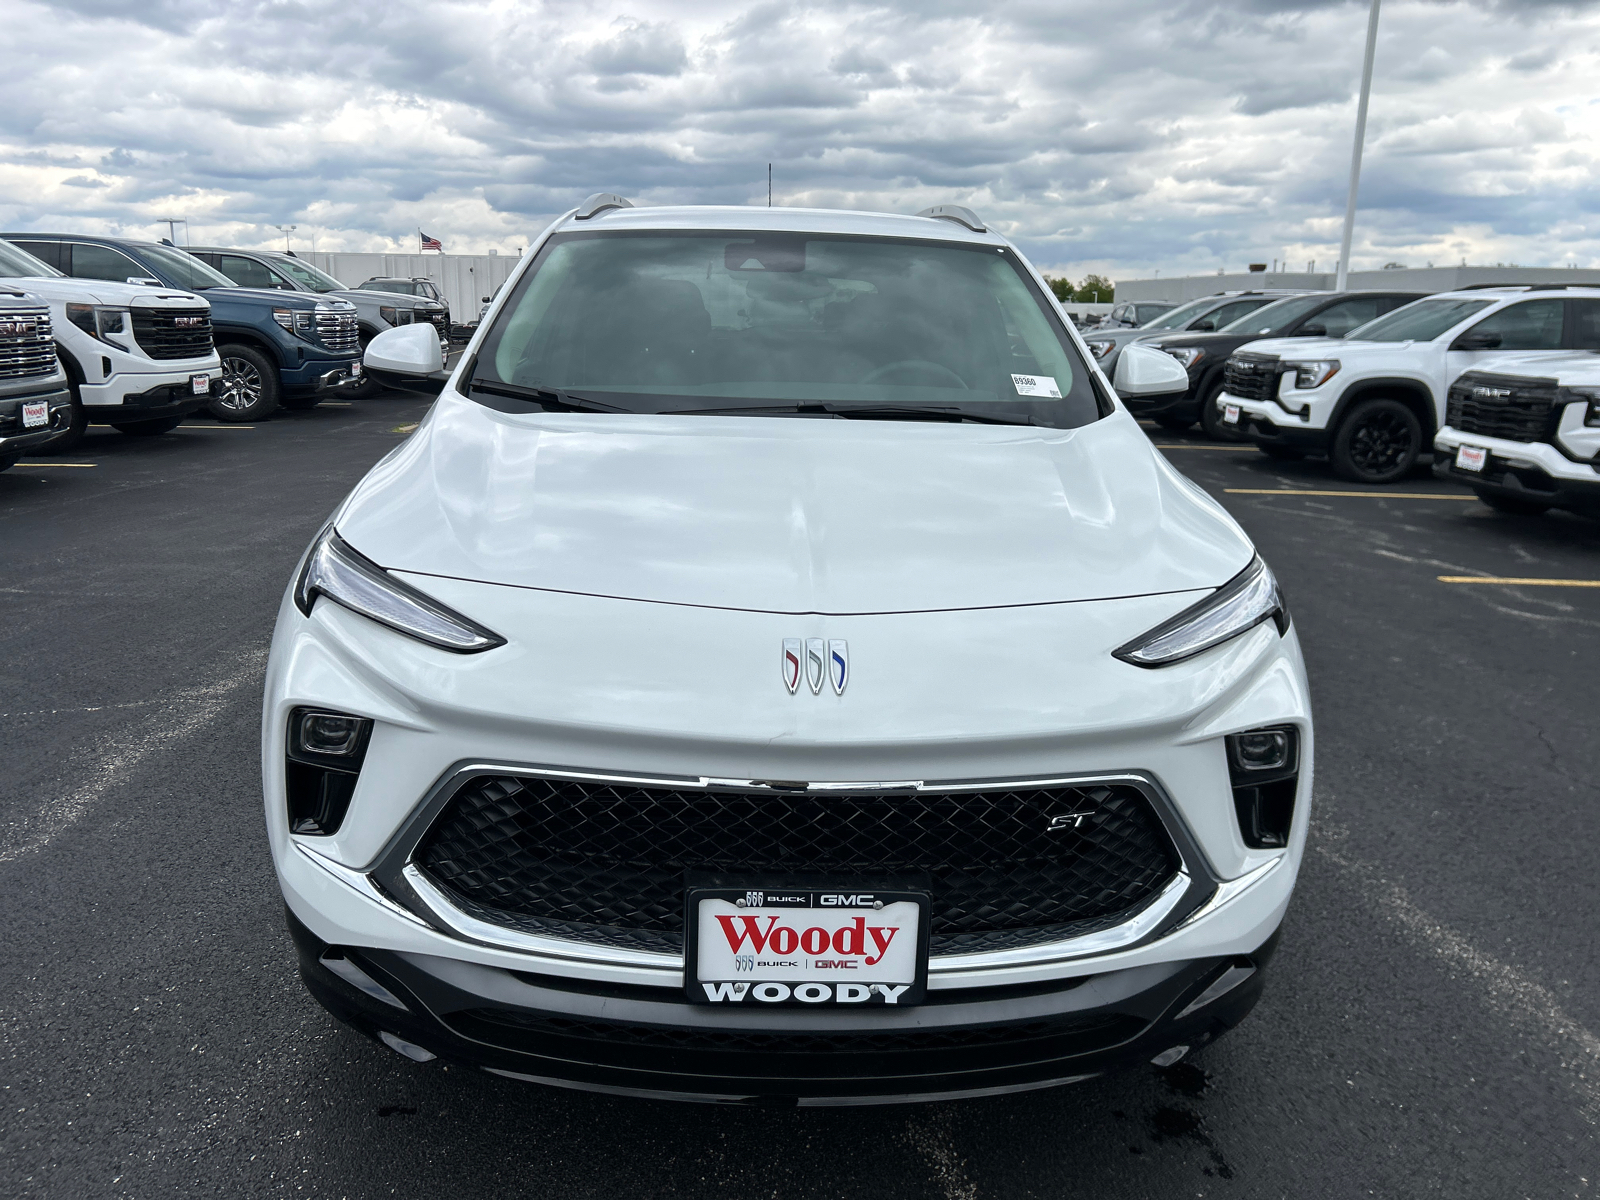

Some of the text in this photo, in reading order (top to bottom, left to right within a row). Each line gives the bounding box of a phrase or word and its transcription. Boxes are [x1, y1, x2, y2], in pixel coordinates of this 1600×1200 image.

[24, 406, 45, 417] Woody
[820, 894, 875, 906] GMC
[714, 915, 900, 966] Woody
[814, 959, 858, 969] GMC
[702, 982, 911, 1004] WOODY
